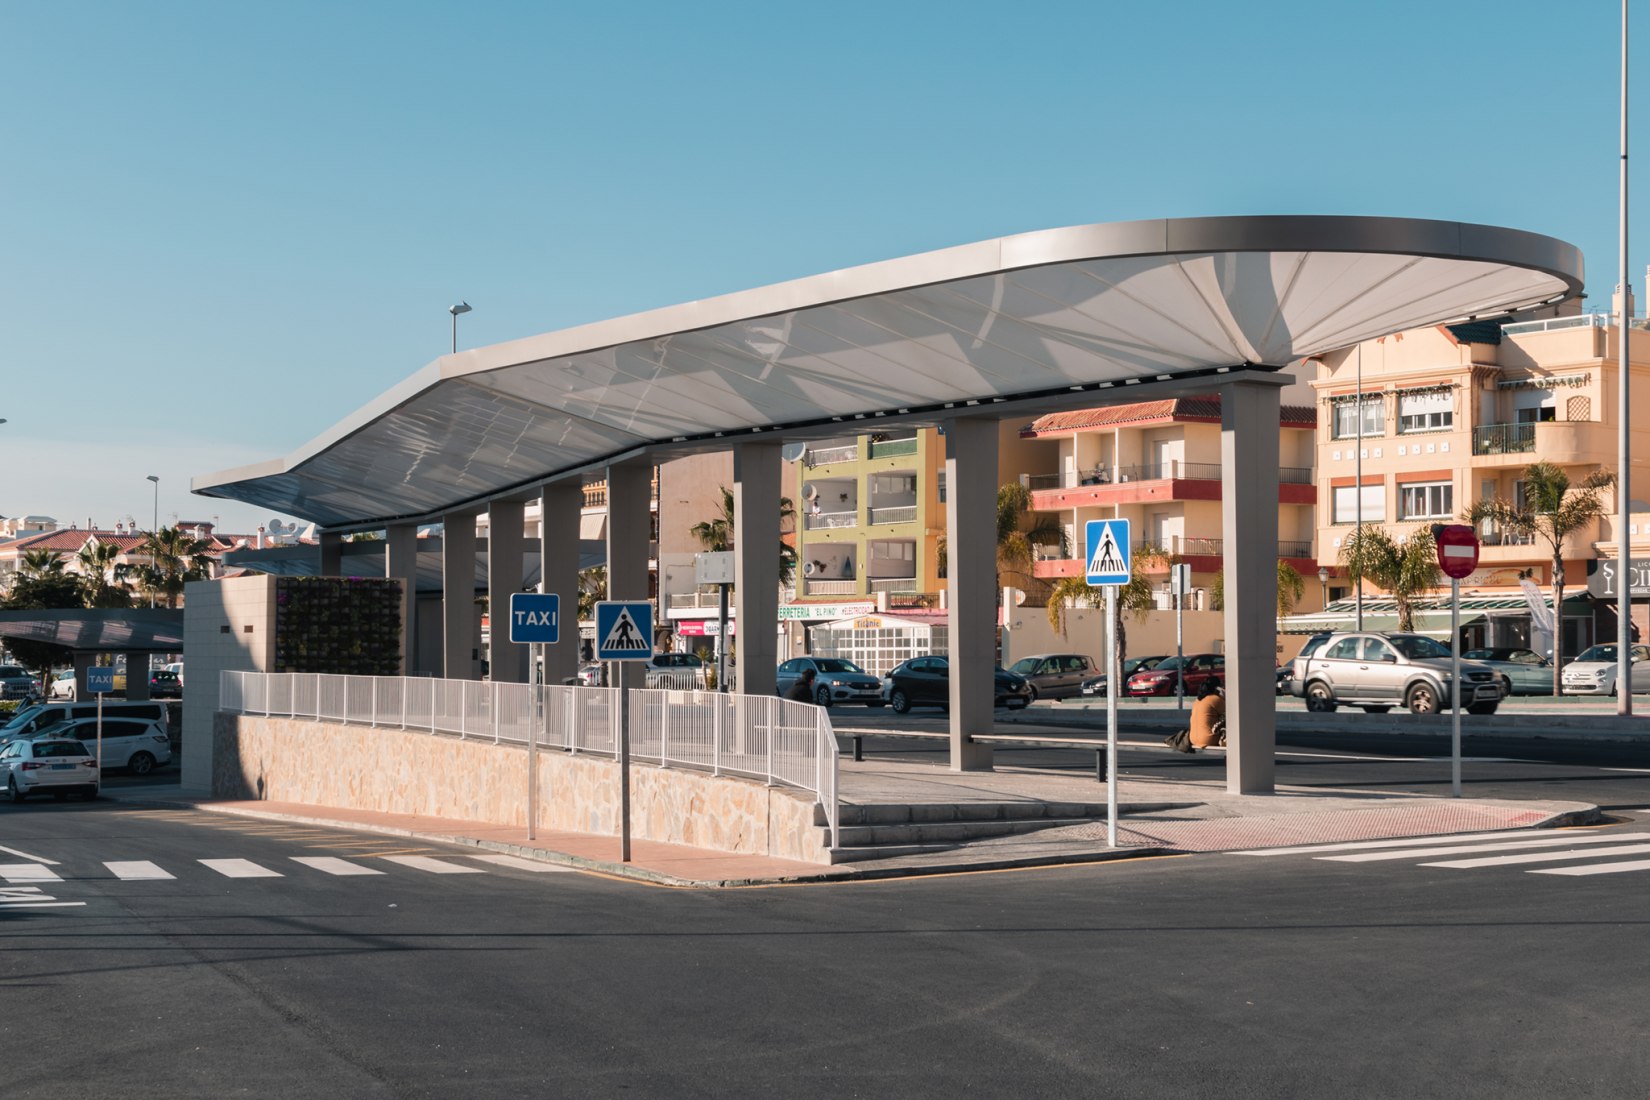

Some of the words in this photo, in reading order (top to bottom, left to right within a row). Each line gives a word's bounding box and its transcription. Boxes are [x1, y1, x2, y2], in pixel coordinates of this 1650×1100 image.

[514, 610, 556, 626] TAXI
[778, 607, 810, 618] ERRETERIA
[89, 675, 112, 684] TAXI
